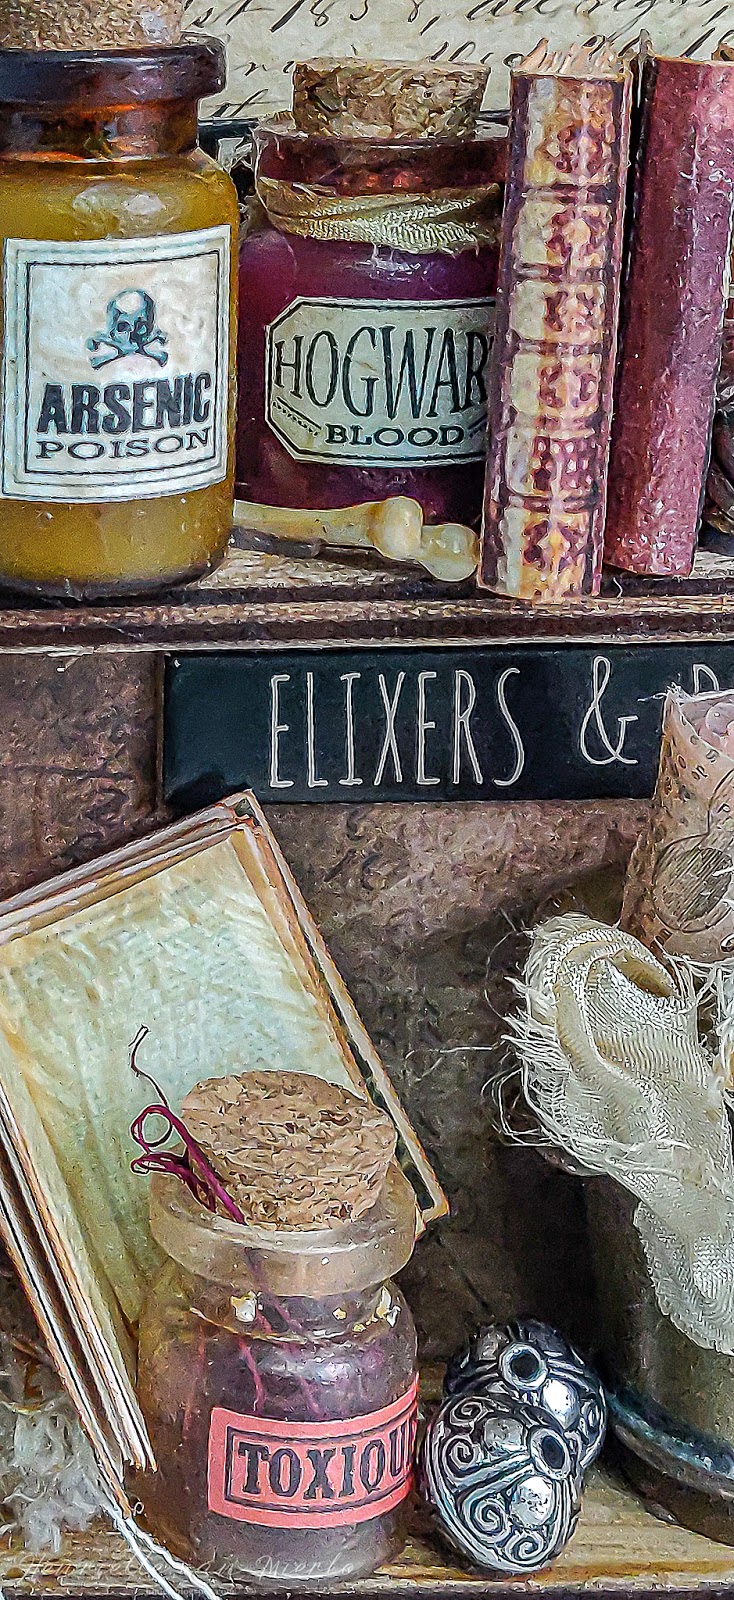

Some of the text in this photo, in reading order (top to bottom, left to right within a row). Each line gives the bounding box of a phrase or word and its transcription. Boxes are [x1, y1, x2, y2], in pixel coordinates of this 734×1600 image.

[37, 372, 211, 435] ARSENIC
[274, 325, 494, 420] HOGWAR
[36, 428, 209, 459] POISON
[325, 423, 464, 447] BLOOD
[269, 667, 526, 788] ELIXERS
[580, 656, 639, 765] &
